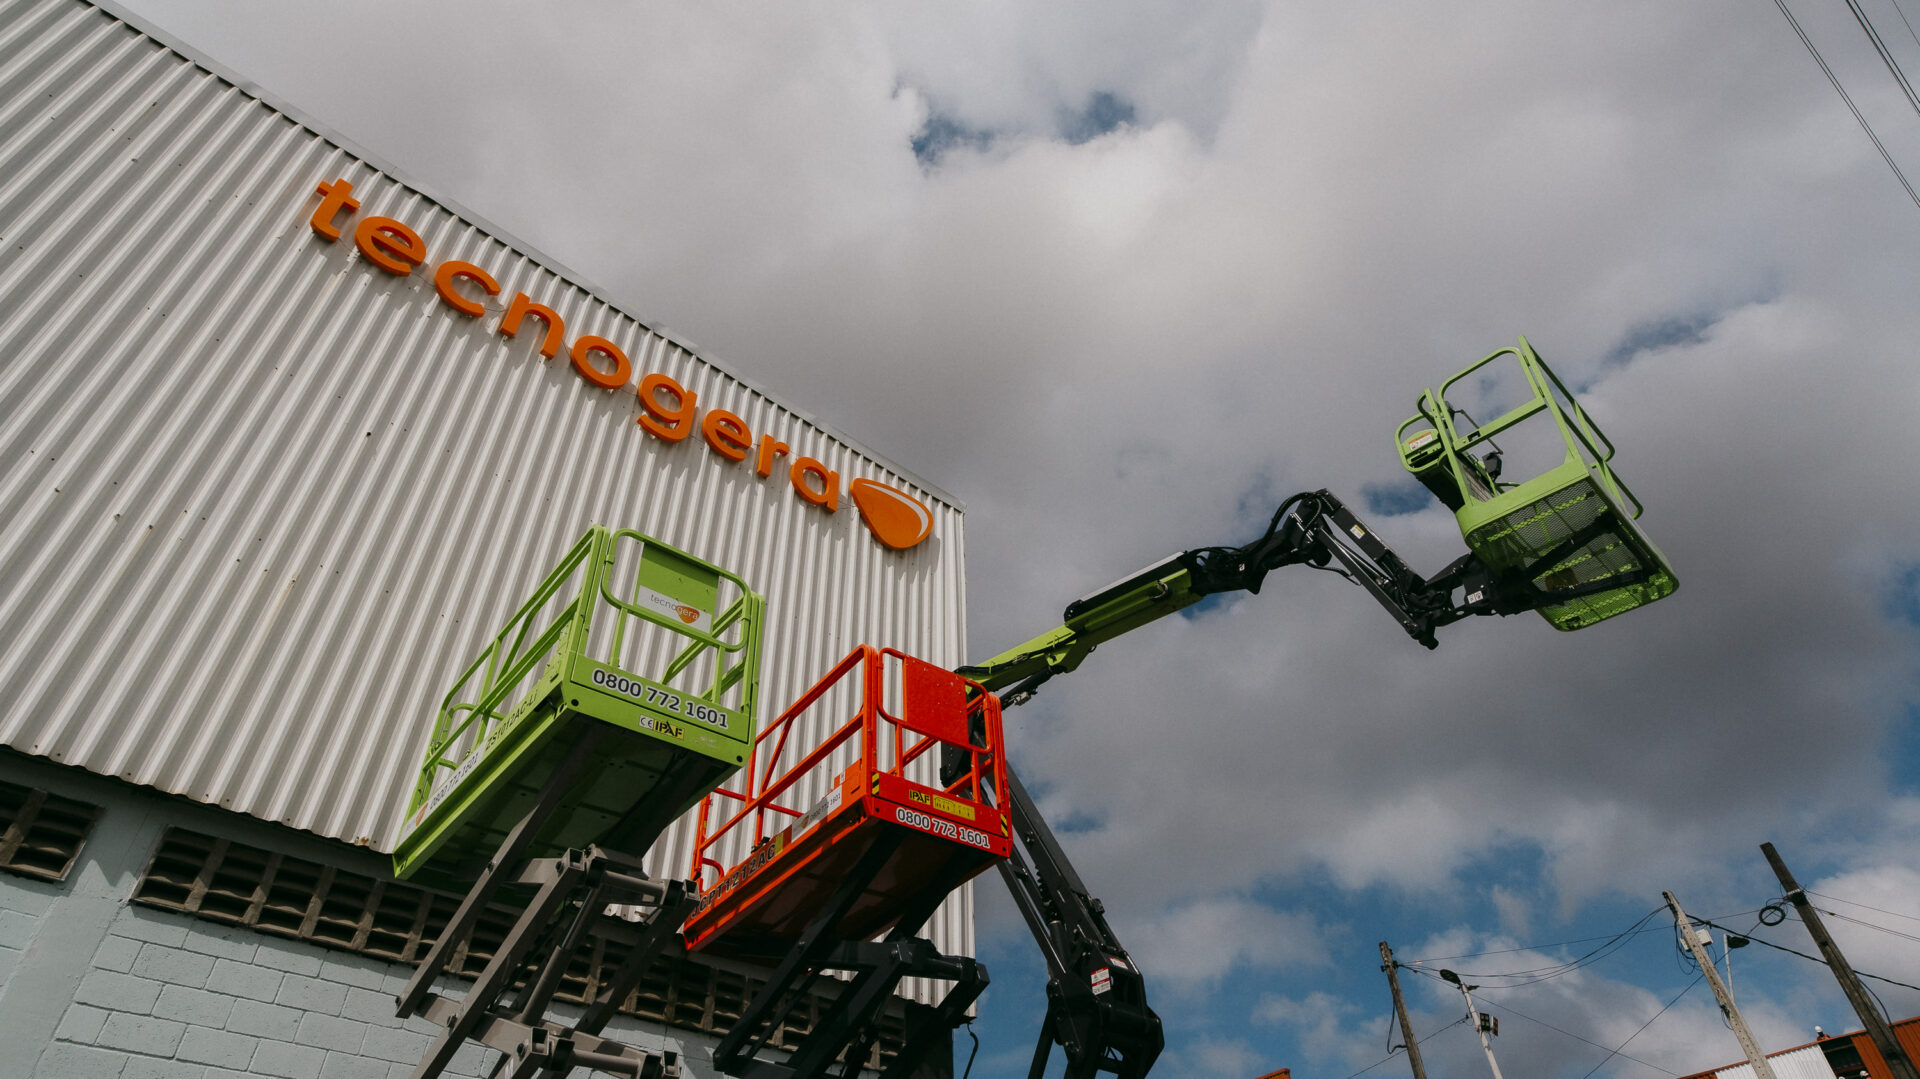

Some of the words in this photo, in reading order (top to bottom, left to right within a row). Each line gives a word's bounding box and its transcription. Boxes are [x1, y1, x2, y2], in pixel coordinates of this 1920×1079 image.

[310, 178, 839, 512] tecnogera
[593, 669, 641, 697] 0800
[647, 687, 680, 711] 772
[686, 701, 728, 728] 1601
[654, 719, 684, 738] IPAF
[909, 790, 930, 804] IPAF
[897, 808, 930, 829] 0800
[932, 820, 957, 838] 772
[960, 828, 990, 848] 1601
[691, 842, 777, 919] JCPT1212AC
